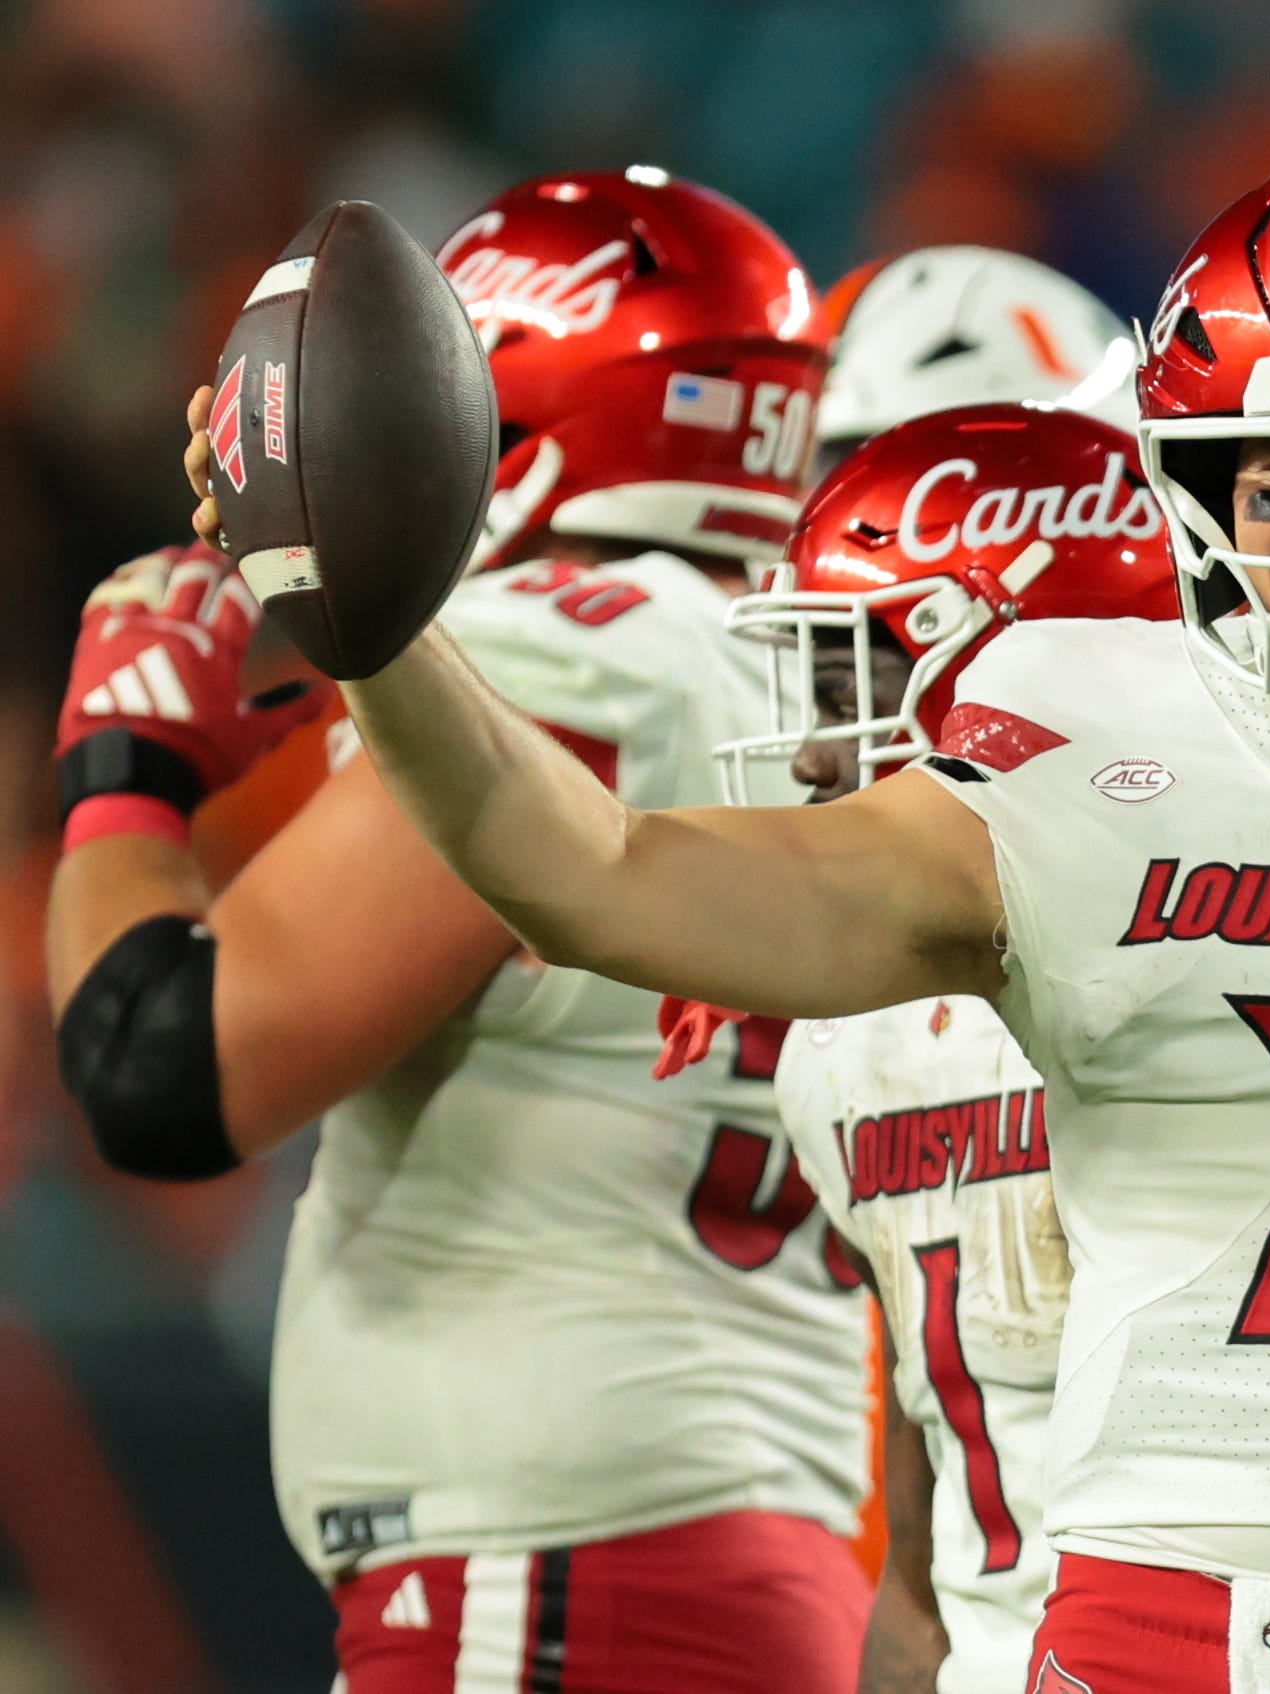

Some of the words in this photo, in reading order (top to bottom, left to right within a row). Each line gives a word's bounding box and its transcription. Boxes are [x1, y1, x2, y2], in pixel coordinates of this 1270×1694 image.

[264, 360, 287, 465] DIME
[742, 380, 812, 480] 50
[899, 451, 1163, 562] Cards
[1103, 769, 1164, 785] ACC
[909, 1235, 1022, 1576] 1
